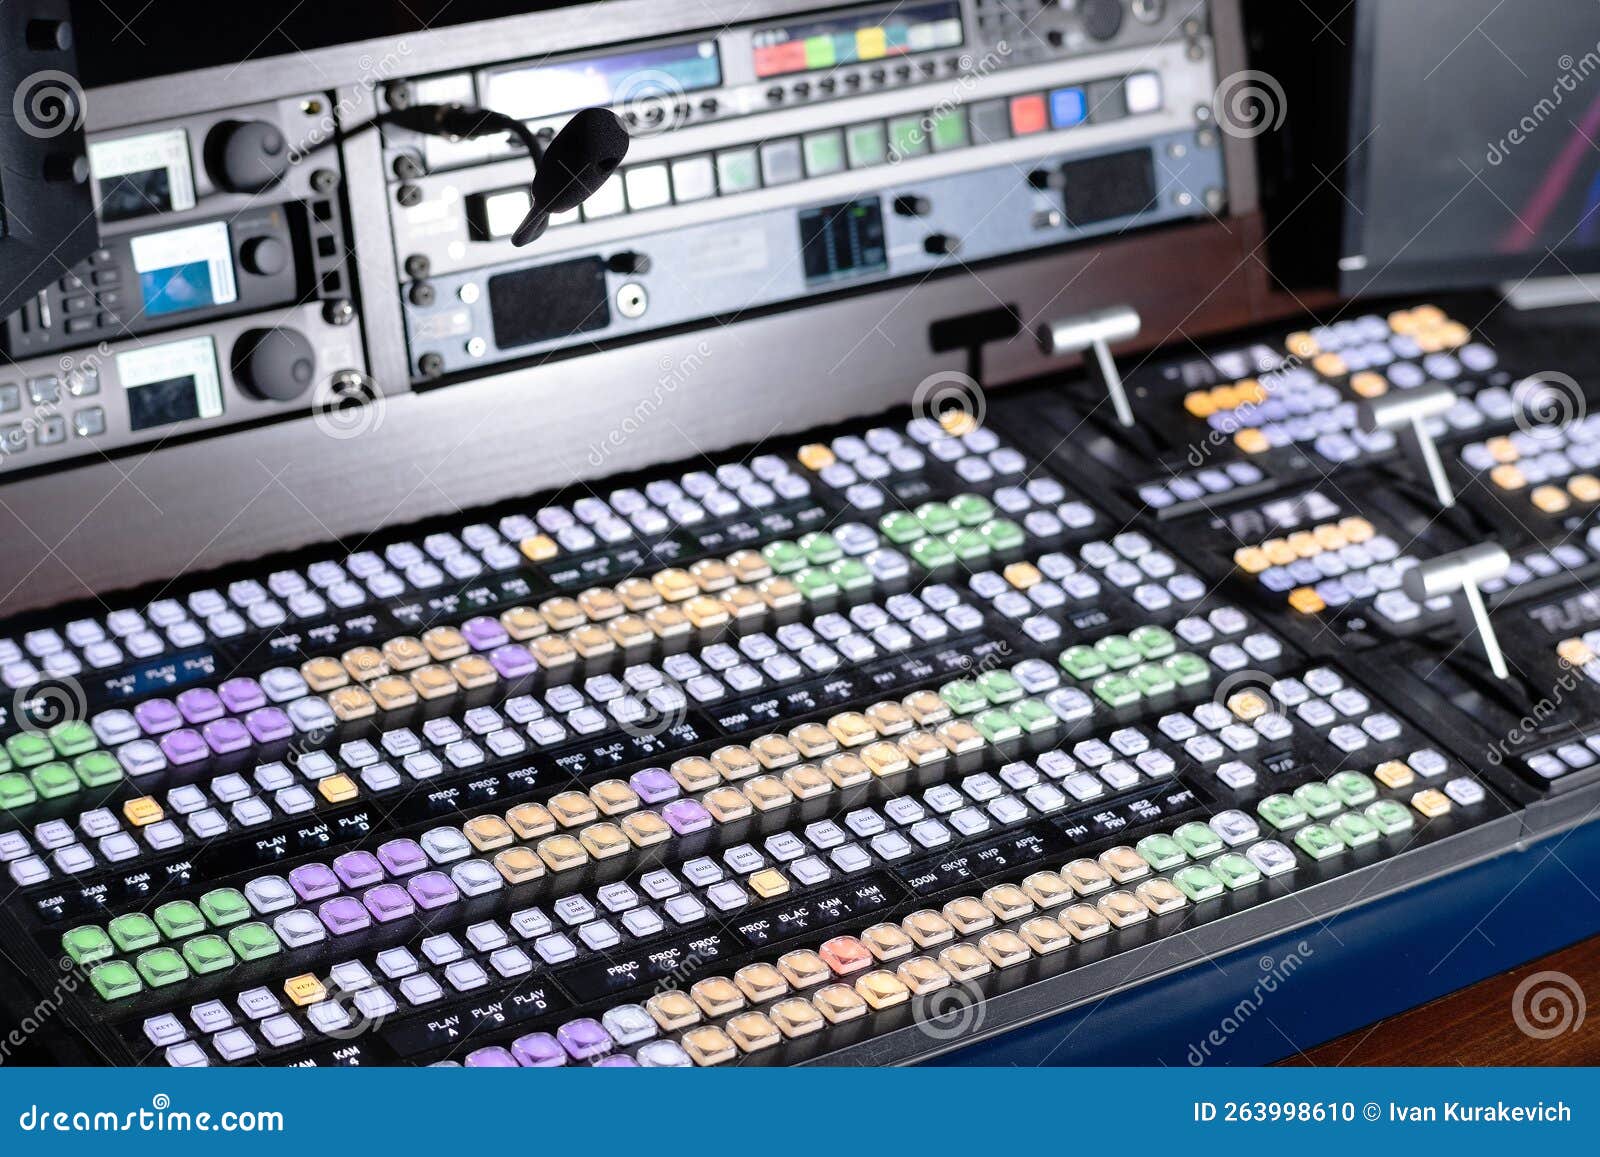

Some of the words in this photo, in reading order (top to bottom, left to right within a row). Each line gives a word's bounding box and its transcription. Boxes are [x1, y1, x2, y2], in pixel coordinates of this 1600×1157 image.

[556, 753, 586, 768] PROC
[610, 752, 622, 761] K
[508, 766, 538, 781] PROC
[468, 777, 499, 792] PROC
[524, 776, 535, 785] 3
[428, 788, 459, 802] PROC
[487, 787, 497, 796] 2
[1140, 805, 1161, 818] PRV
[338, 812, 369, 828] PLAY
[1105, 817, 1127, 829] PRV
[298, 823, 328, 839] PLAY
[359, 821, 370, 831] D
[256, 835, 286, 850] PLAY
[318, 832, 330, 842] B
[1015, 835, 1043, 849] APPL
[778, 839, 794, 848] AUX4
[1031, 845, 1043, 853] E
[275, 846, 286, 856] A
[737, 851, 753, 860] AUX3
[978, 848, 999, 860] HYP
[941, 857, 968, 872] SKYP
[996, 856, 1006, 864] 3
[166, 861, 192, 874] KAM
[695, 864, 712, 873] AUX2
[958, 868, 970, 877] E
[124, 873, 150, 886] KAM
[180, 871, 190, 879] 4
[908, 873, 938, 888] ZOOM
[652, 876, 669, 886] AUX1
[81, 884, 107, 897] KAM
[138, 883, 149, 891] 3
[856, 886, 880, 898] KAM
[38, 896, 65, 909] KAM
[94, 894, 107, 903] 2
[818, 898, 842, 910] KAM
[870, 894, 887, 903] 5!
[53, 906, 63, 914] 1
[778, 908, 809, 922] BLAC
[739, 920, 770, 935] PROC
[797, 919, 808, 928] K
[689, 936, 720, 951] PROC
[649, 948, 680, 963] PROC
[708, 947, 718, 955] 3
[607, 961, 639, 976] PROC
[667, 960, 679, 968] 2
[627, 972, 636, 980] 1
[296, 981, 315, 991] KEY4
[250, 995, 269, 1005] KEY3
[513, 989, 546, 1006] PLAY
[536, 1000, 547, 1009] D
[203, 1007, 222, 1018] KEY2
[471, 1002, 503, 1019] PLAY
[494, 1011, 505, 1022] B
[428, 1016, 459, 1032] PLAY
[448, 1027, 458, 1038] A
[333, 1046, 360, 1060] KAM
[350, 1057, 359, 1065] 4
